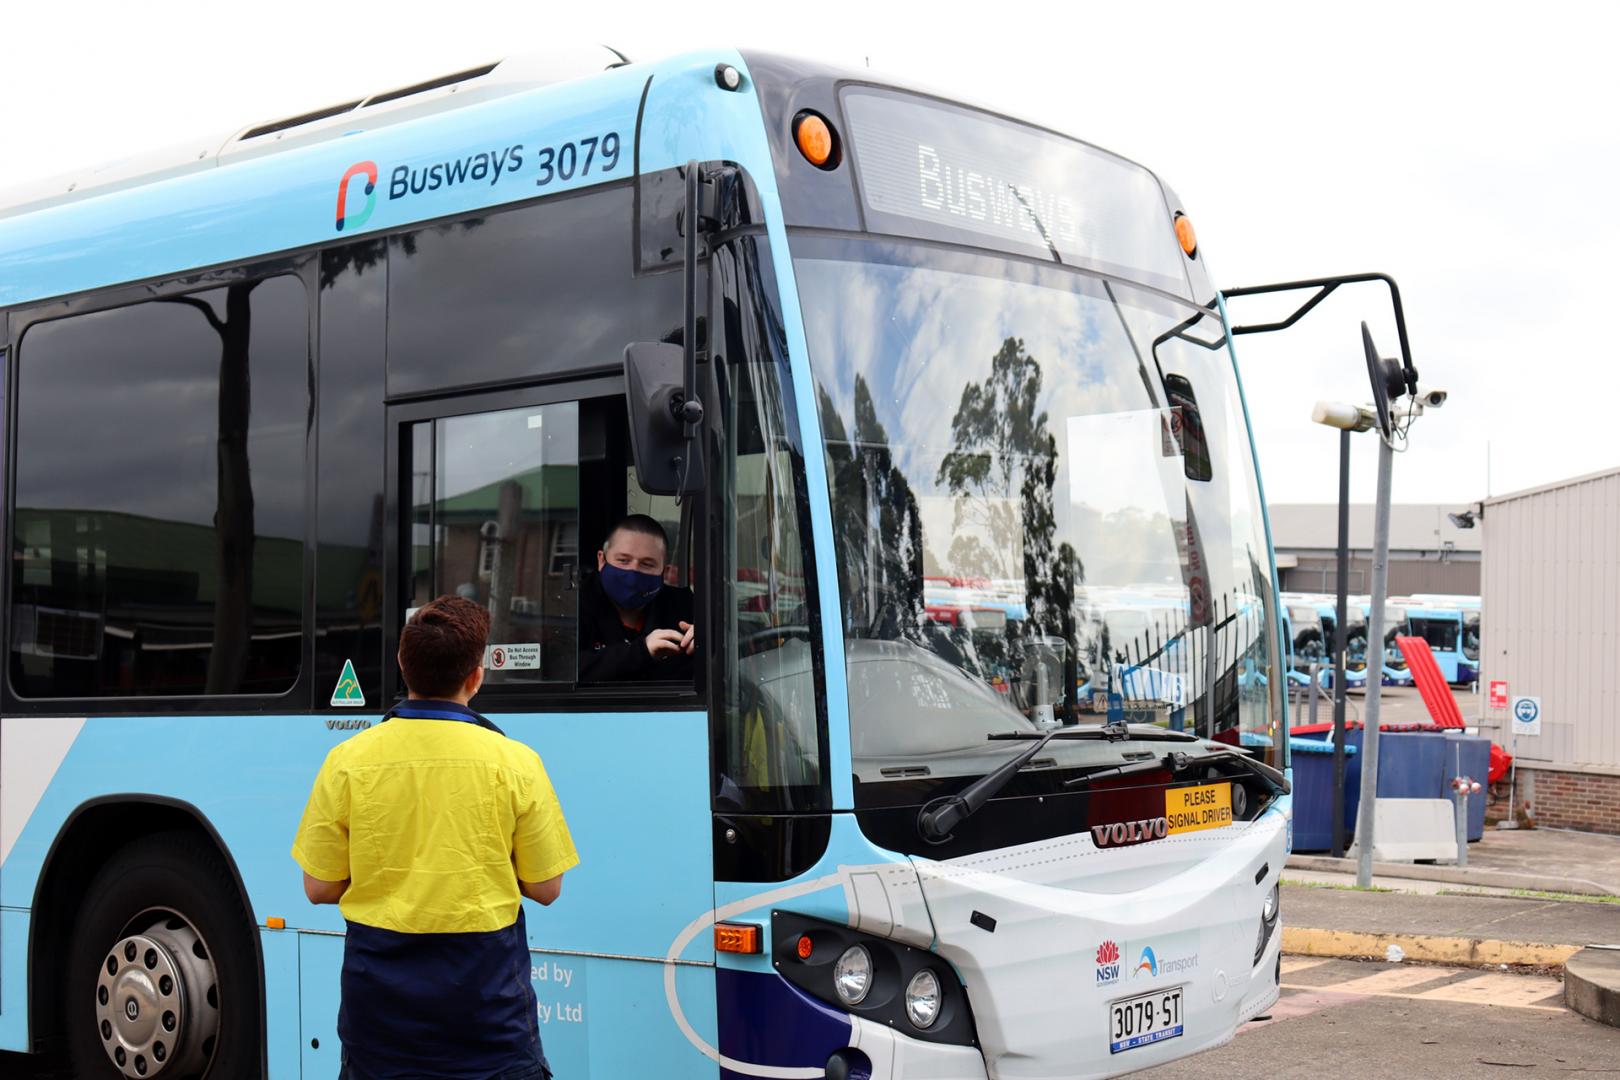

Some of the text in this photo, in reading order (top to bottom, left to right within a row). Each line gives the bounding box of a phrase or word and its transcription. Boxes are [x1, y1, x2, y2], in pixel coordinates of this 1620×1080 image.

[389, 132, 620, 201] Busways 3079
[326, 720, 371, 730] VOLVO
[1184, 789, 1216, 807] PLEASE
[1168, 806, 1231, 829] SIGNAL DRIVER
[1091, 816, 1168, 846] VOLVO
[530, 962, 573, 987] ed by
[1096, 965, 1120, 982] NSW
[1158, 953, 1199, 974] Transport
[537, 1001, 583, 1024] ty Ltd
